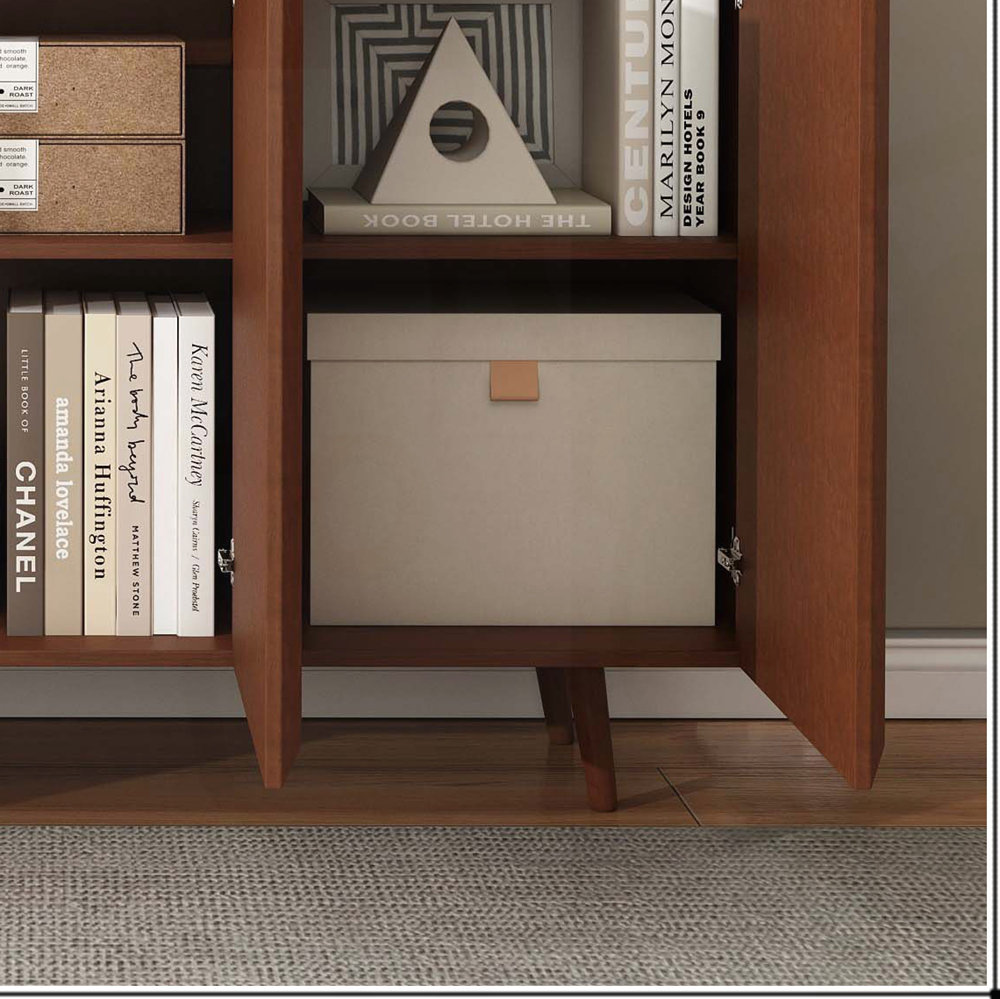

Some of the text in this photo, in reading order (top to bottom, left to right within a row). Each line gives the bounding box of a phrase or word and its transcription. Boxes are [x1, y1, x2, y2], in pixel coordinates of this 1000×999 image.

[660, 78, 675, 218] MARILYN
[683, 88, 693, 227] DESIGN HOTELS
[695, 109, 705, 227] YEAR BOOK 9
[363, 214, 591, 228] THE HOTEL BOOK
[20, 349, 29, 433] LITTLE BOOK OF
[118, 341, 149, 504] The body beyond
[185, 343, 208, 487] Karen McCartney
[15, 461, 36, 593] CHANEL
[55, 397, 73, 560] amanda lovelace
[89, 371, 112, 579] Arianna Huffington
[132, 525, 140, 616] MATTHEW STONE
